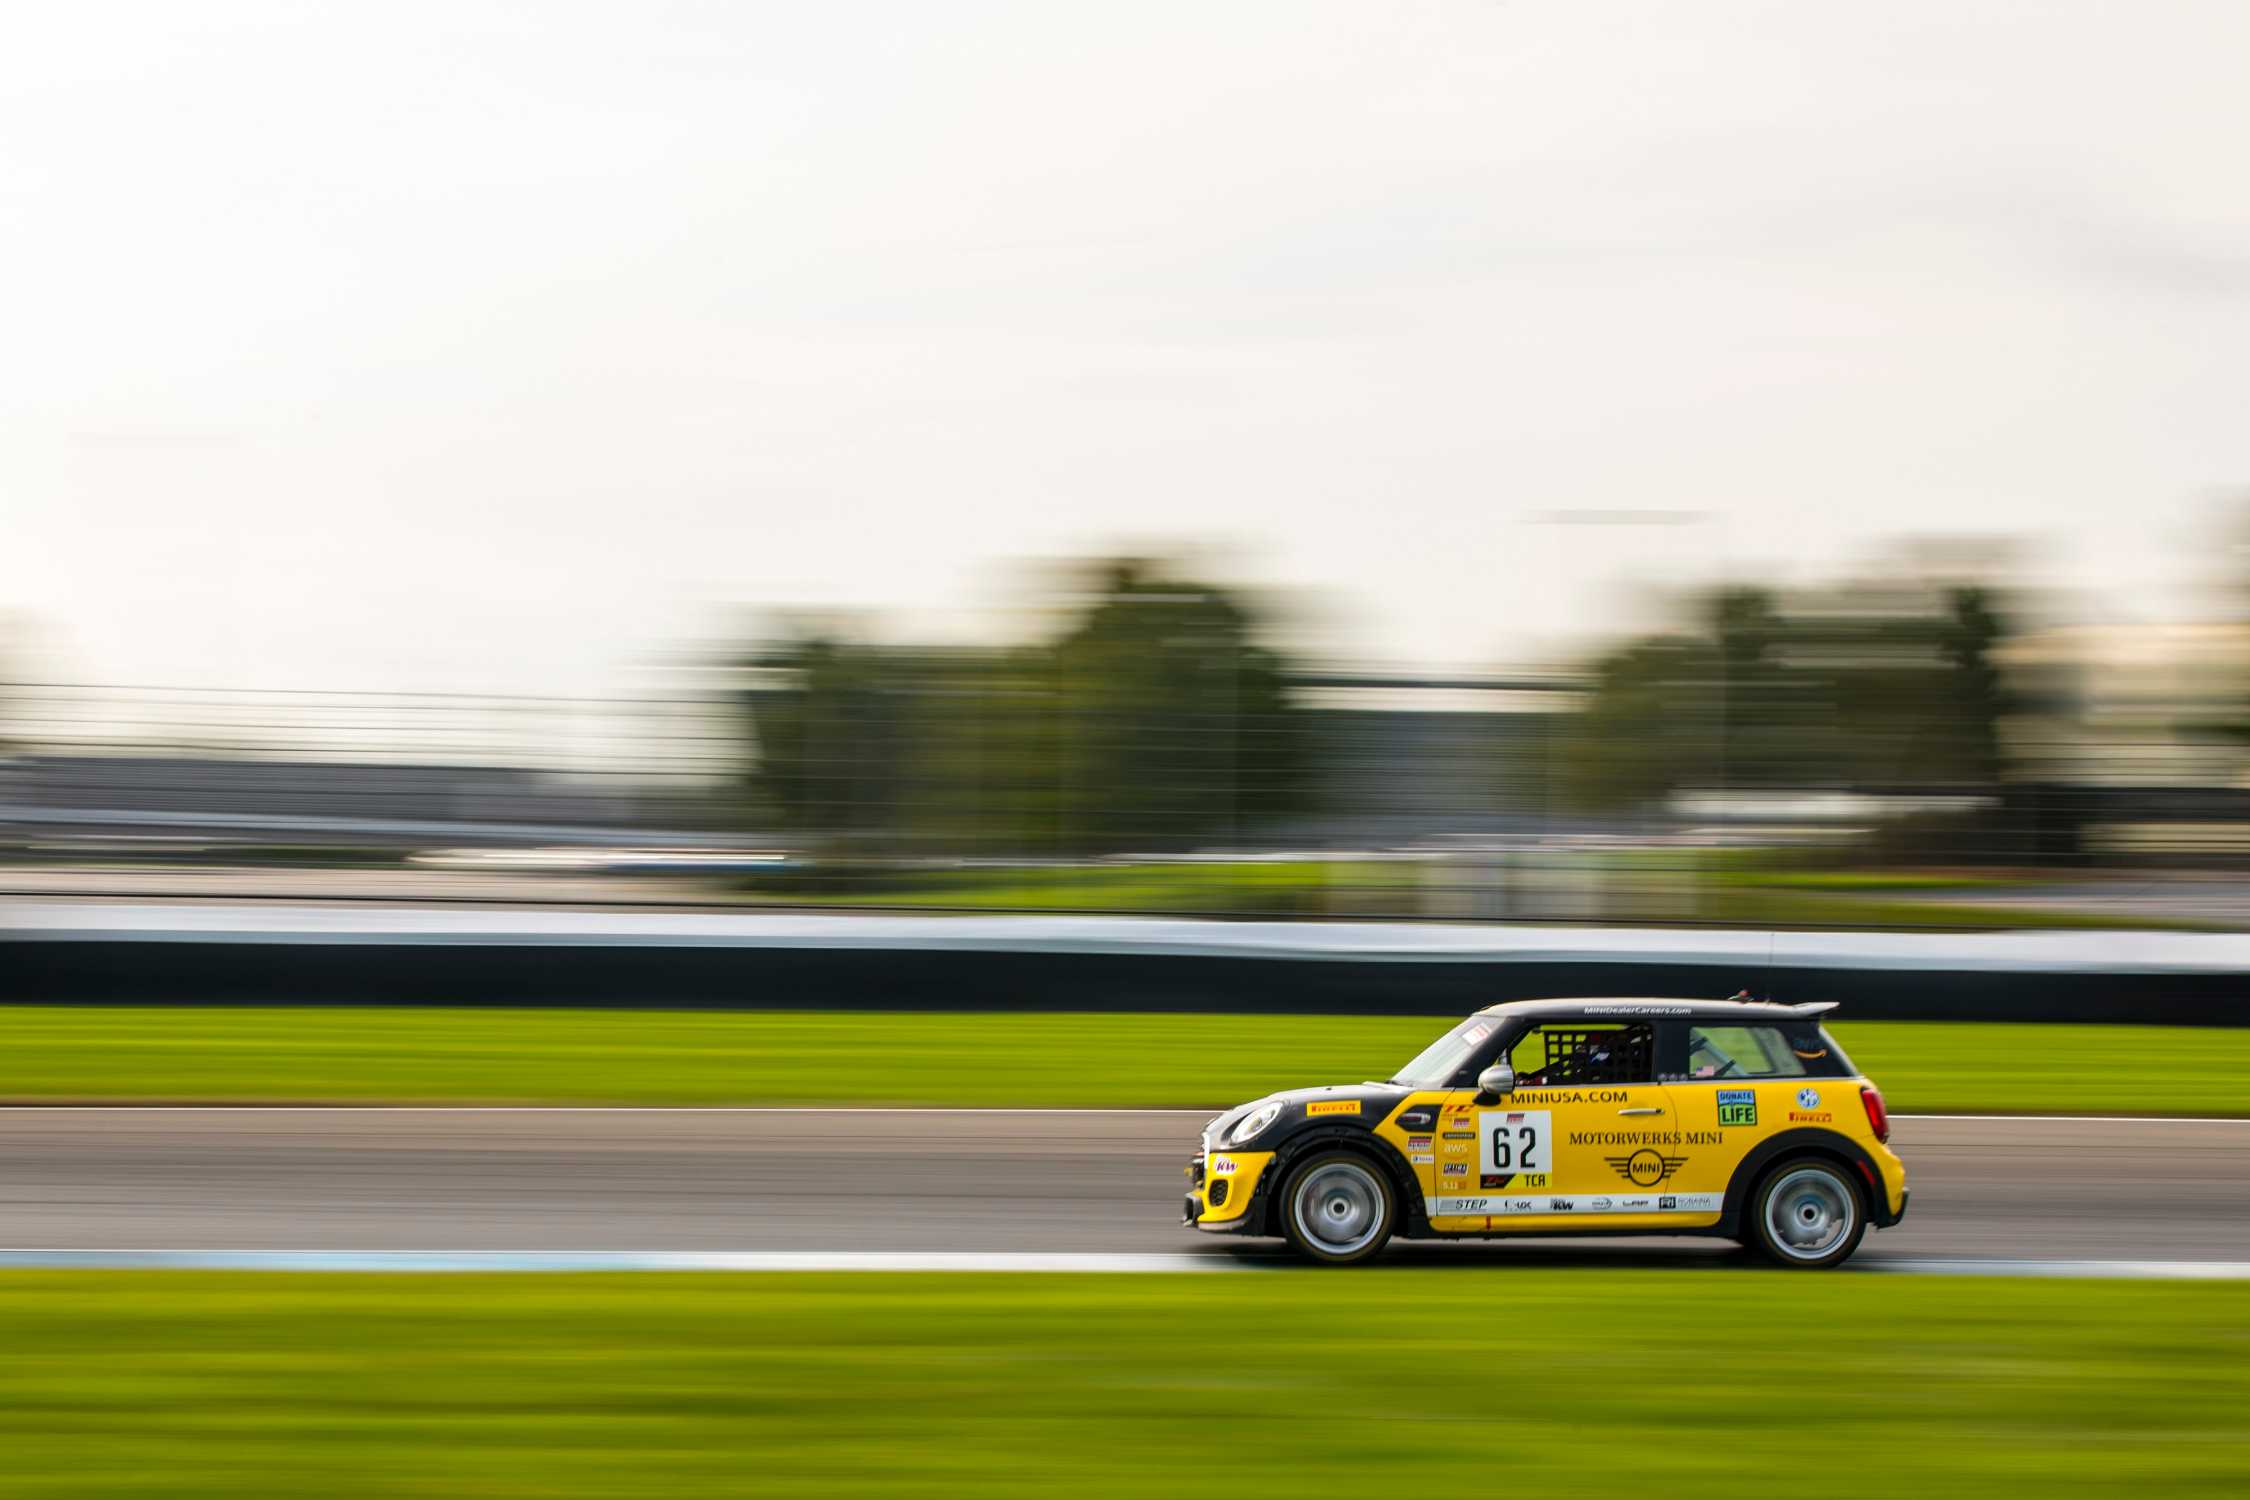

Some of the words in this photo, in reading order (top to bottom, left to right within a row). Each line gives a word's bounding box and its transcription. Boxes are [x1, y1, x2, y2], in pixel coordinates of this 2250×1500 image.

[1511, 1091, 1628, 1104] MINIUSA.COM
[1721, 1107, 1754, 1123] LIFE
[1569, 1132, 1682, 1145] MOTORWERKS
[1686, 1132, 1723, 1144] MINI
[1493, 1127, 1536, 1168] 62
[1632, 1163, 1661, 1174] MINI
[1524, 1174, 1546, 1187] TCA
[1456, 1200, 1488, 1209] STEP
